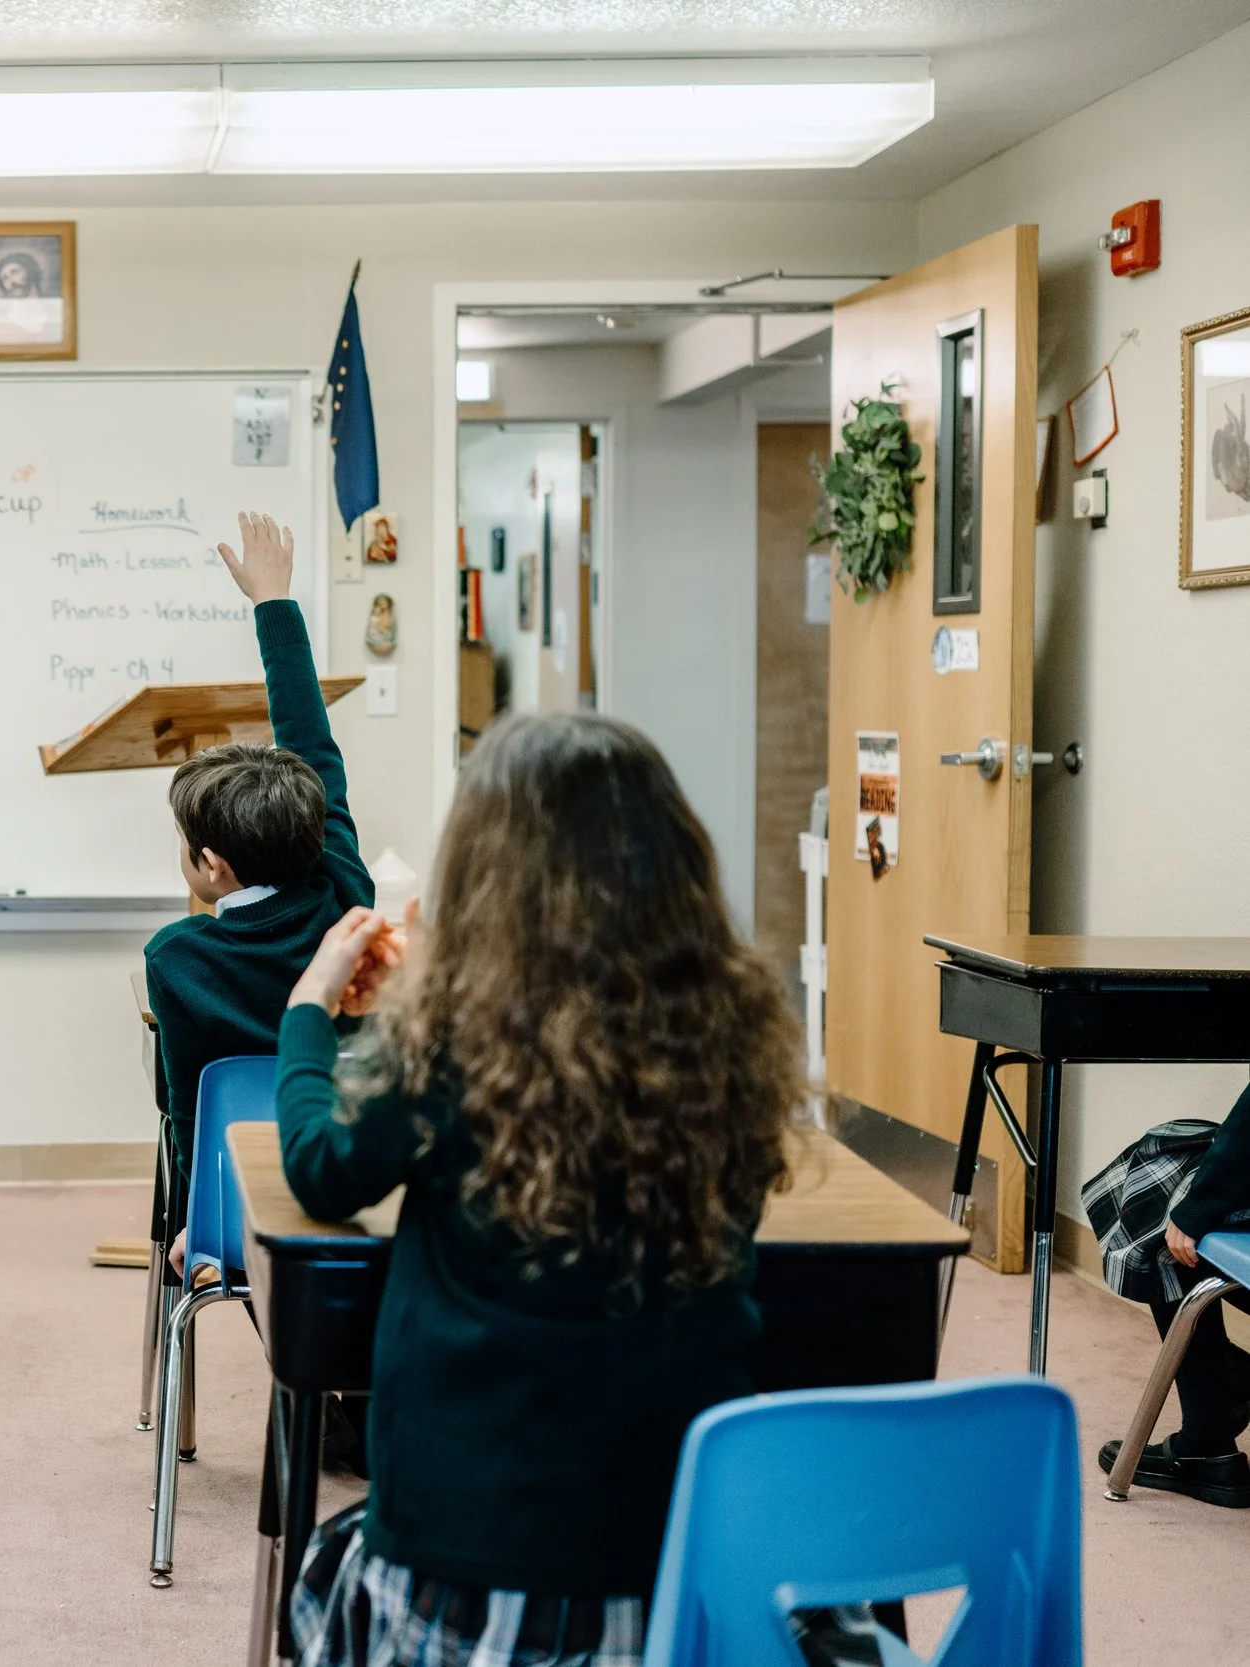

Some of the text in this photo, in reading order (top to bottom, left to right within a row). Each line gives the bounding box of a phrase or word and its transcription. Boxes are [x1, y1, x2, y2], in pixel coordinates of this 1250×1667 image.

[90, 497, 192, 523] Homework
[125, 551, 193, 570] Lesson
[51, 598, 130, 621] Phonics
[154, 599, 250, 622] Worksheet
[126, 657, 150, 682] Ch
[161, 659, 175, 683] 4
